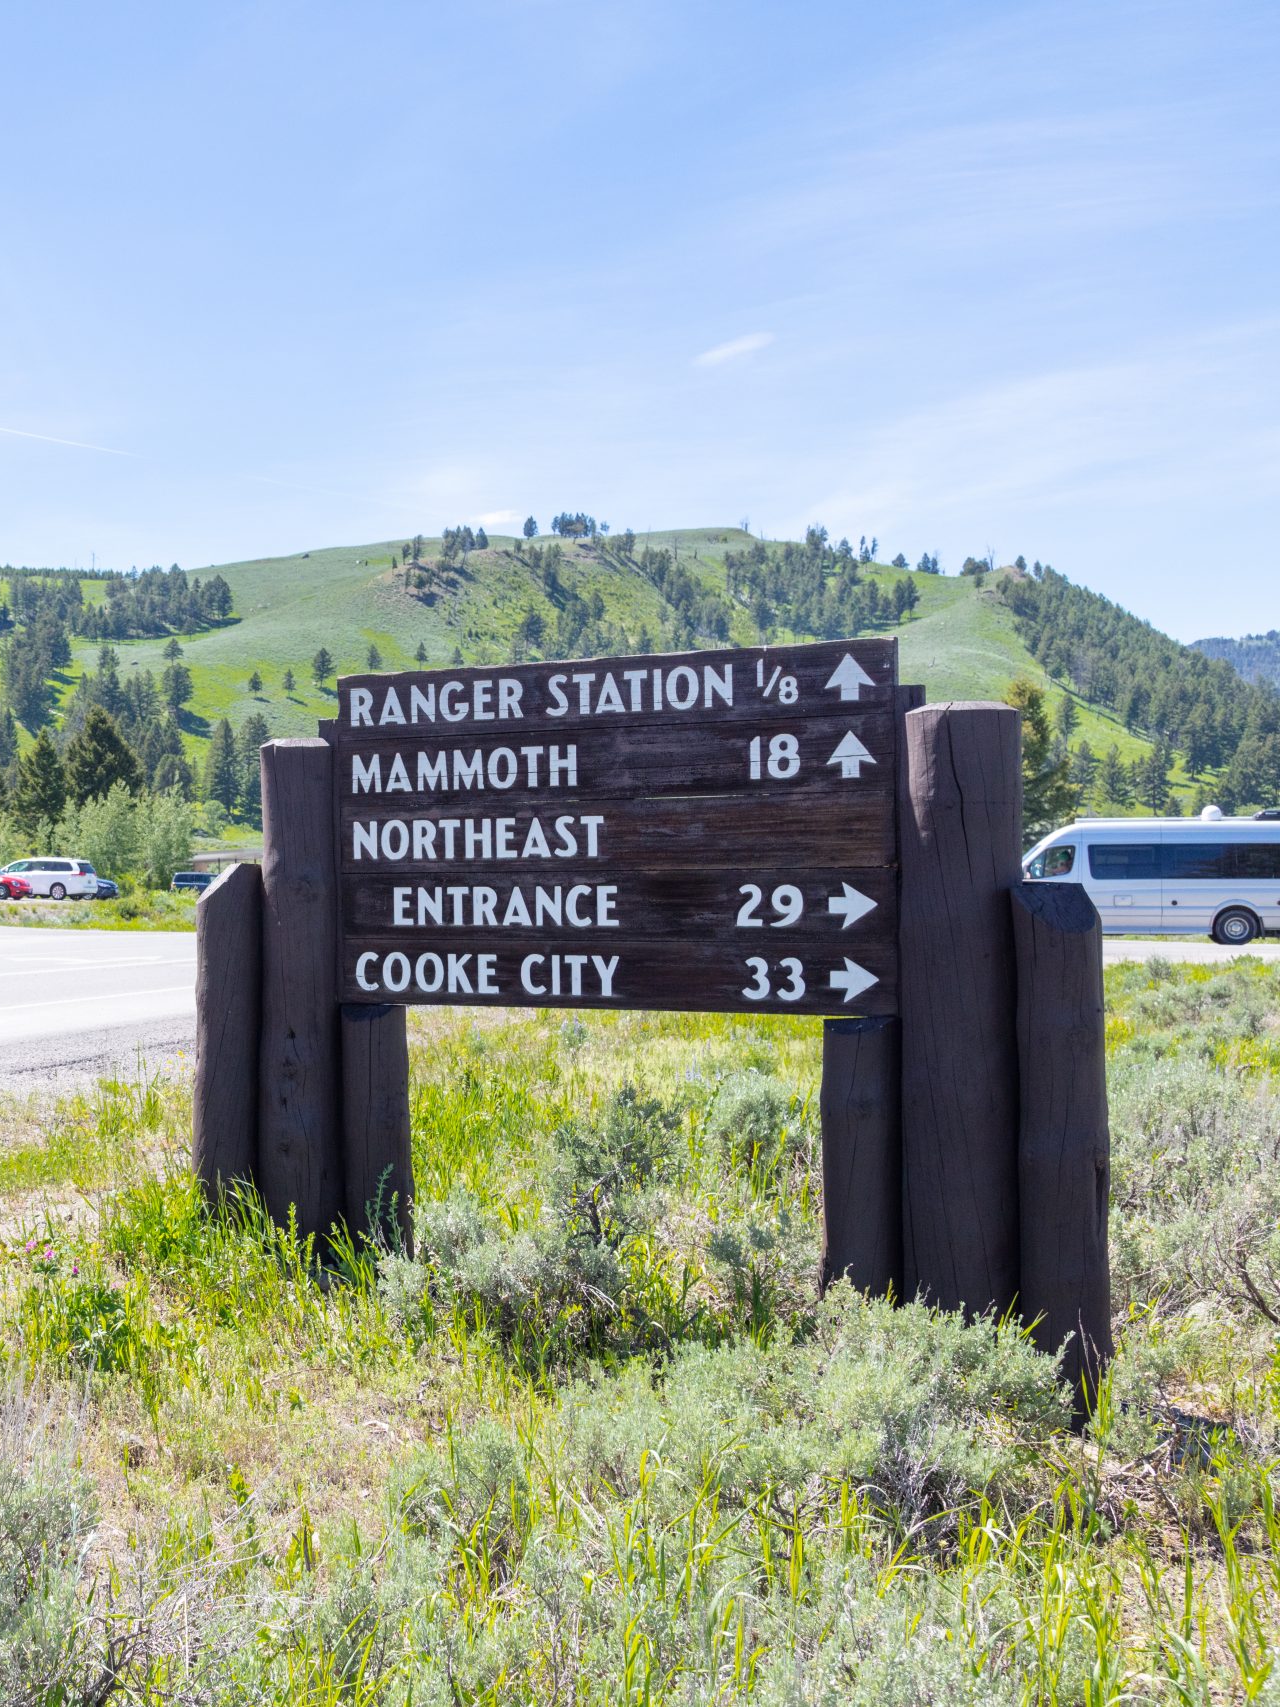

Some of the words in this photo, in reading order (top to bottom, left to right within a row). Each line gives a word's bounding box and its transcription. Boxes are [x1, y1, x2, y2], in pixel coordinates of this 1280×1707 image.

[350, 677, 524, 728] RANGER
[545, 663, 733, 717] STATION
[756, 658, 799, 705] 1/8
[352, 744, 578, 794] MAMMOTH
[749, 733, 801, 780] 18
[353, 815, 605, 861] NORTHEAST
[393, 884, 620, 928] ENTRANCE
[736, 883, 804, 928] 29
[355, 951, 500, 995] COOKE
[520, 953, 620, 997] CITY
[741, 956, 806, 1001] 33
